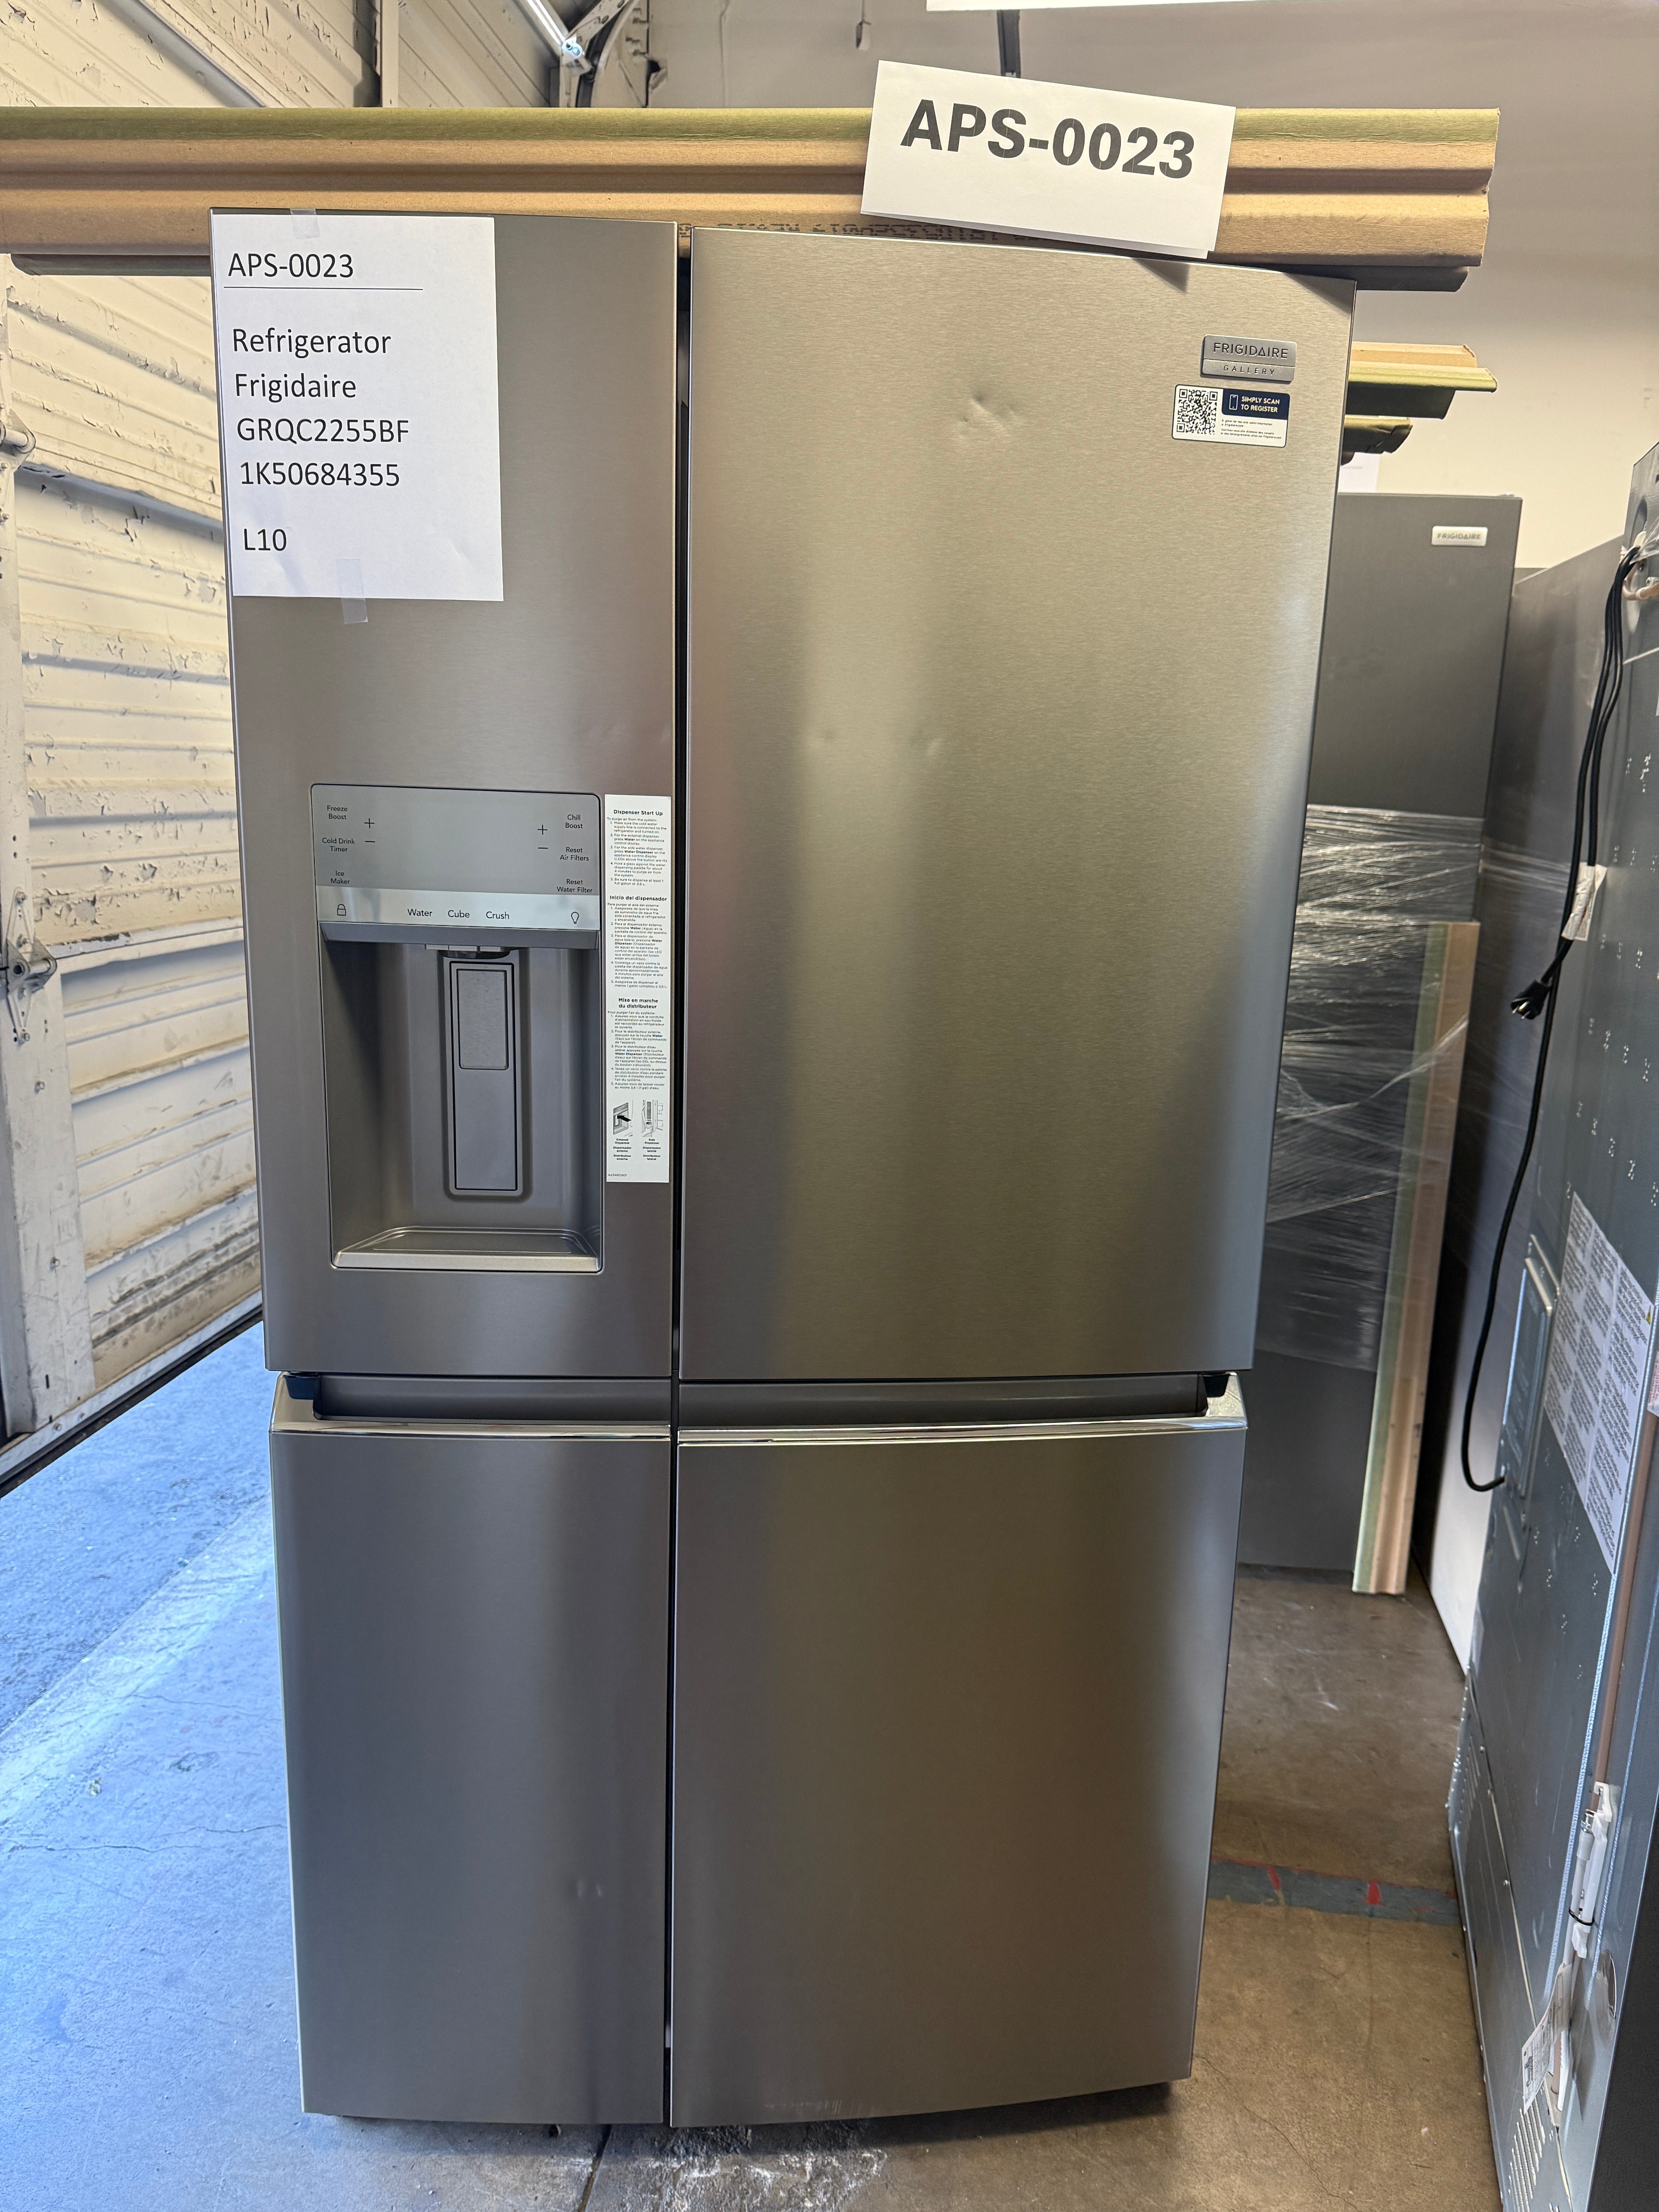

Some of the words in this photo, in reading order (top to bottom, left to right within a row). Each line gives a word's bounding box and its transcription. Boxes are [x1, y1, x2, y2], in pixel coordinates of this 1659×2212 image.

[900, 98, 1195, 179] APS-0023
[228, 253, 353, 278] APS-0023
[233, 327, 391, 359] Refrigerator
[1213, 342, 1288, 359] FRIGIDAIRE
[1223, 365, 1275, 376] GALLERY
[235, 373, 356, 403] Frigidaire
[1250, 405, 1278, 413] REGISTER
[237, 418, 409, 445] GRQC2255BF
[240, 462, 399, 486] 1K50684355
[244, 528, 287, 551] L10
[407, 908, 433, 917] Water
[448, 910, 470, 918] Cube
[486, 911, 509, 919] Crush
